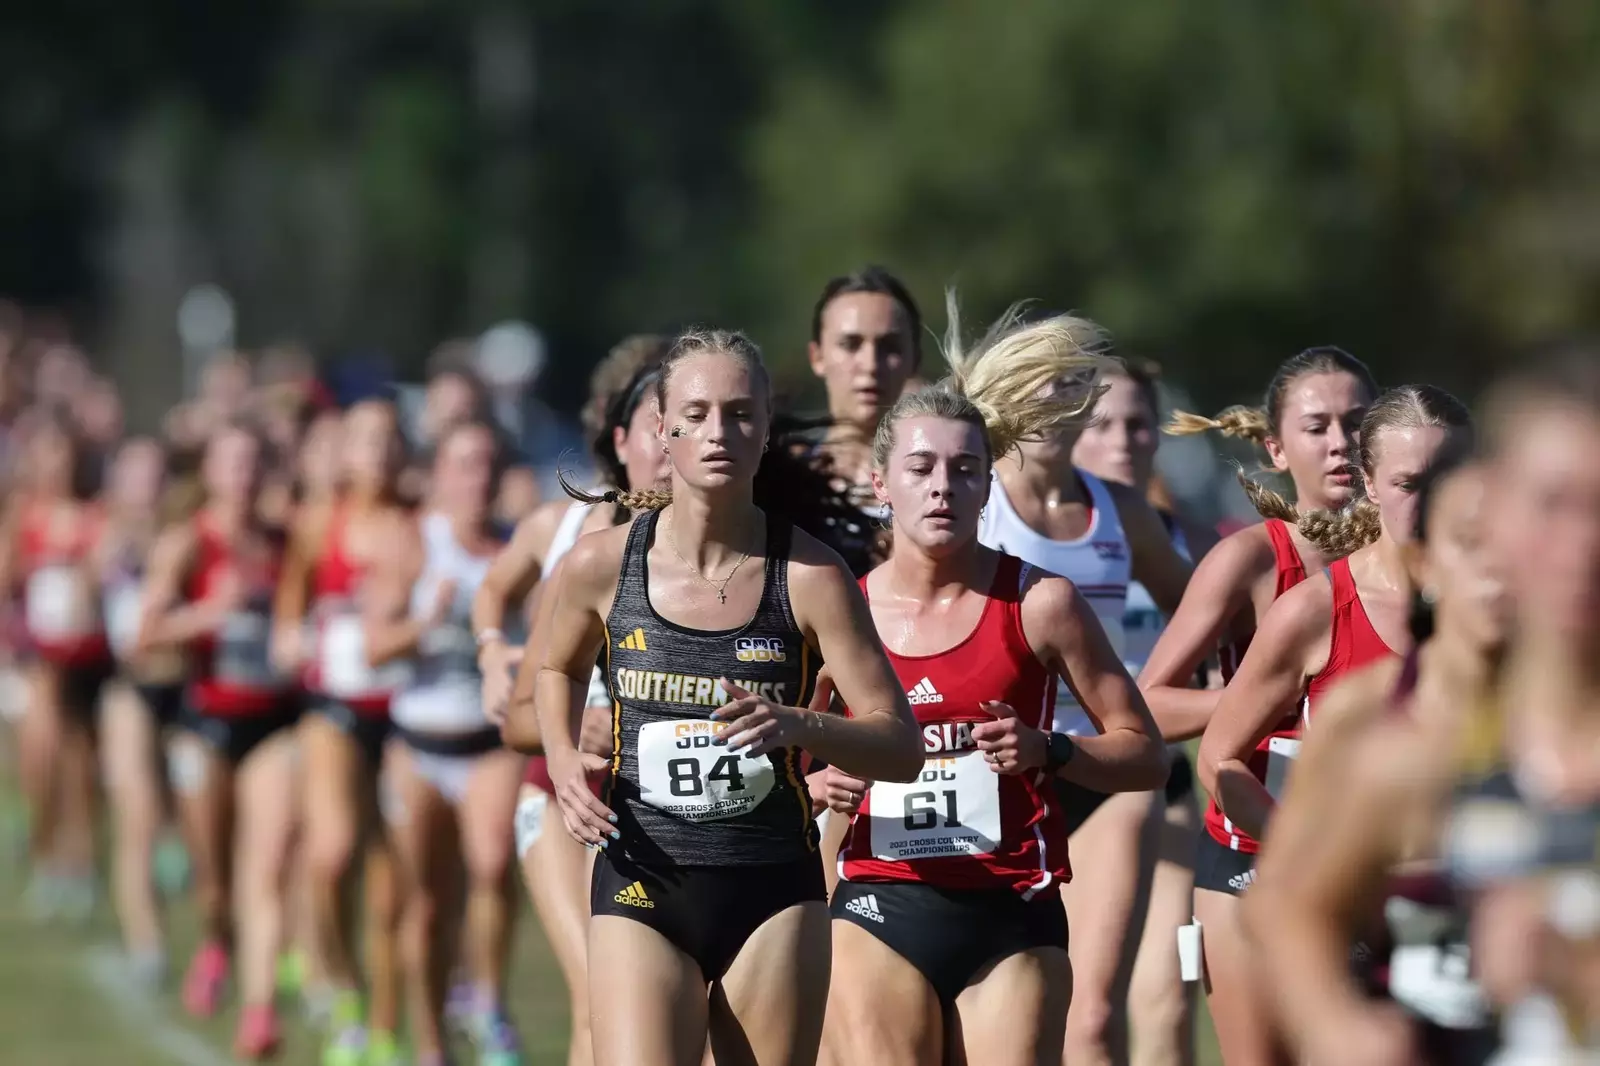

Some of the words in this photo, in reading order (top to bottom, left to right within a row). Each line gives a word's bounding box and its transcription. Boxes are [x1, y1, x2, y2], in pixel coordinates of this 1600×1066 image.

[735, 638, 786, 662] SBC
[617, 668, 727, 706] SOUTHERN
[667, 755, 746, 797] 84
[922, 757, 957, 783] BC
[663, 804, 684, 812] 2023
[685, 803, 713, 812] CROSS
[714, 795, 756, 809] COUNTRY
[903, 789, 962, 831] 61
[889, 840, 908, 849] 2023
[909, 838, 936, 847] CROSS
[937, 836, 979, 845] COUNTRY
[899, 844, 970, 856] CHAMPIONSHIPS
[614, 894, 655, 909] adidas
[845, 902, 885, 923] adidas
